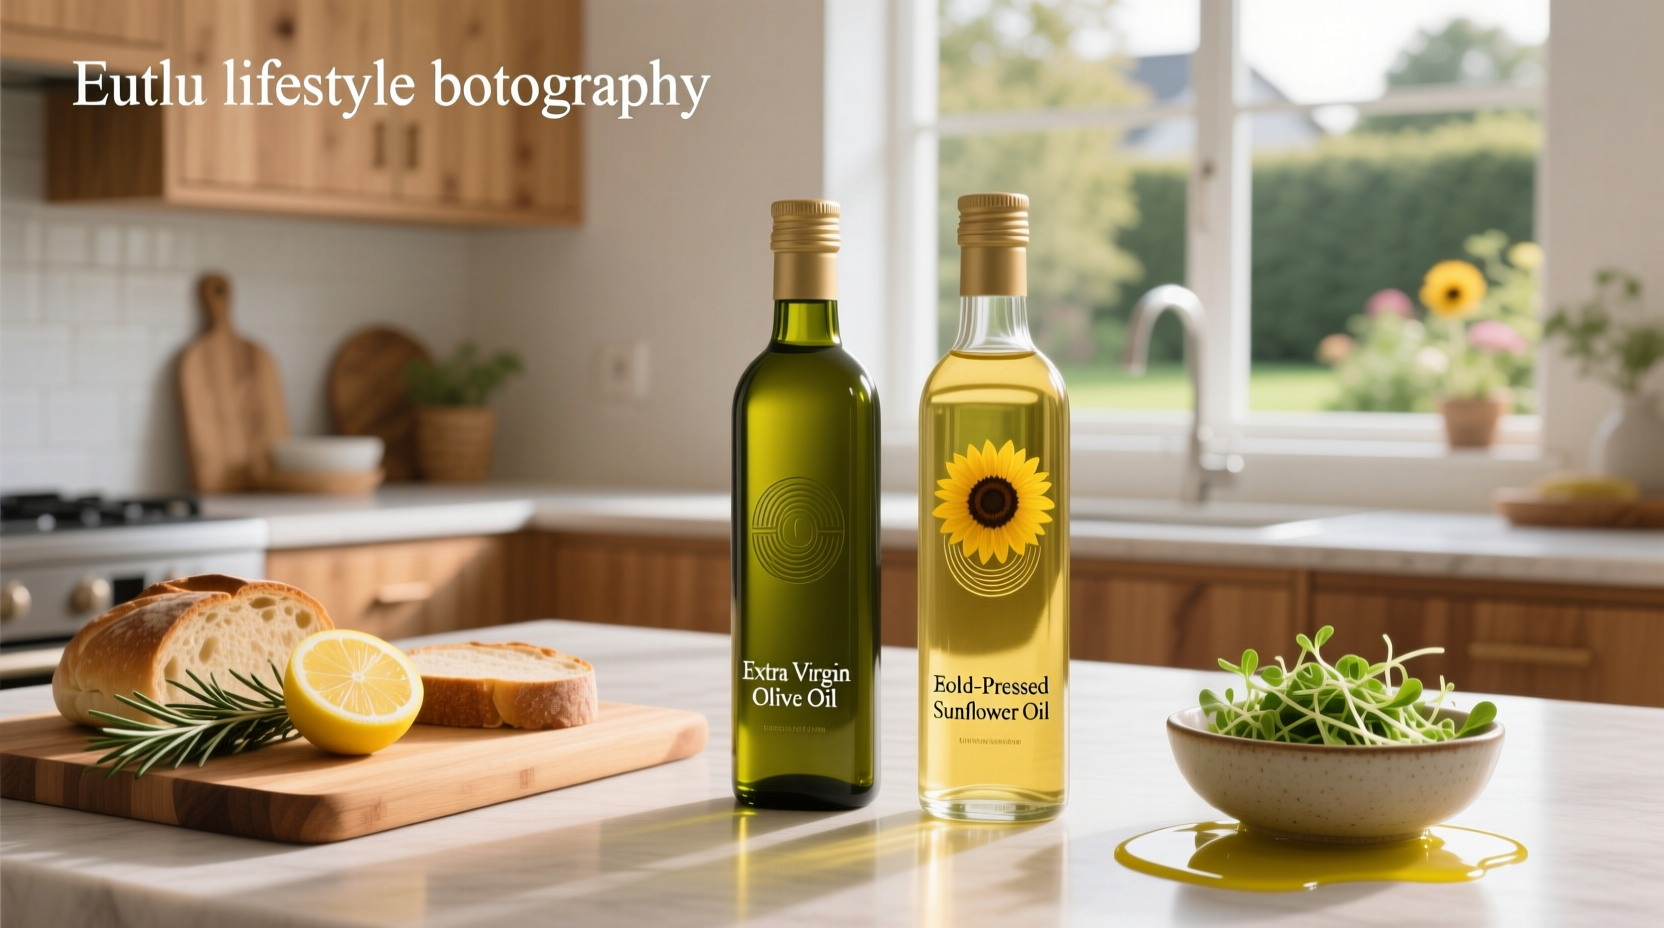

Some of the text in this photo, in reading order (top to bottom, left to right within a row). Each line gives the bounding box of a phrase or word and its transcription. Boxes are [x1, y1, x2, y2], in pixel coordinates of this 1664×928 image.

[742, 660, 851, 688] Extra Virgin
[752, 687, 838, 708] Olive Oil
[933, 700, 1050, 721] Sunflower Oil
